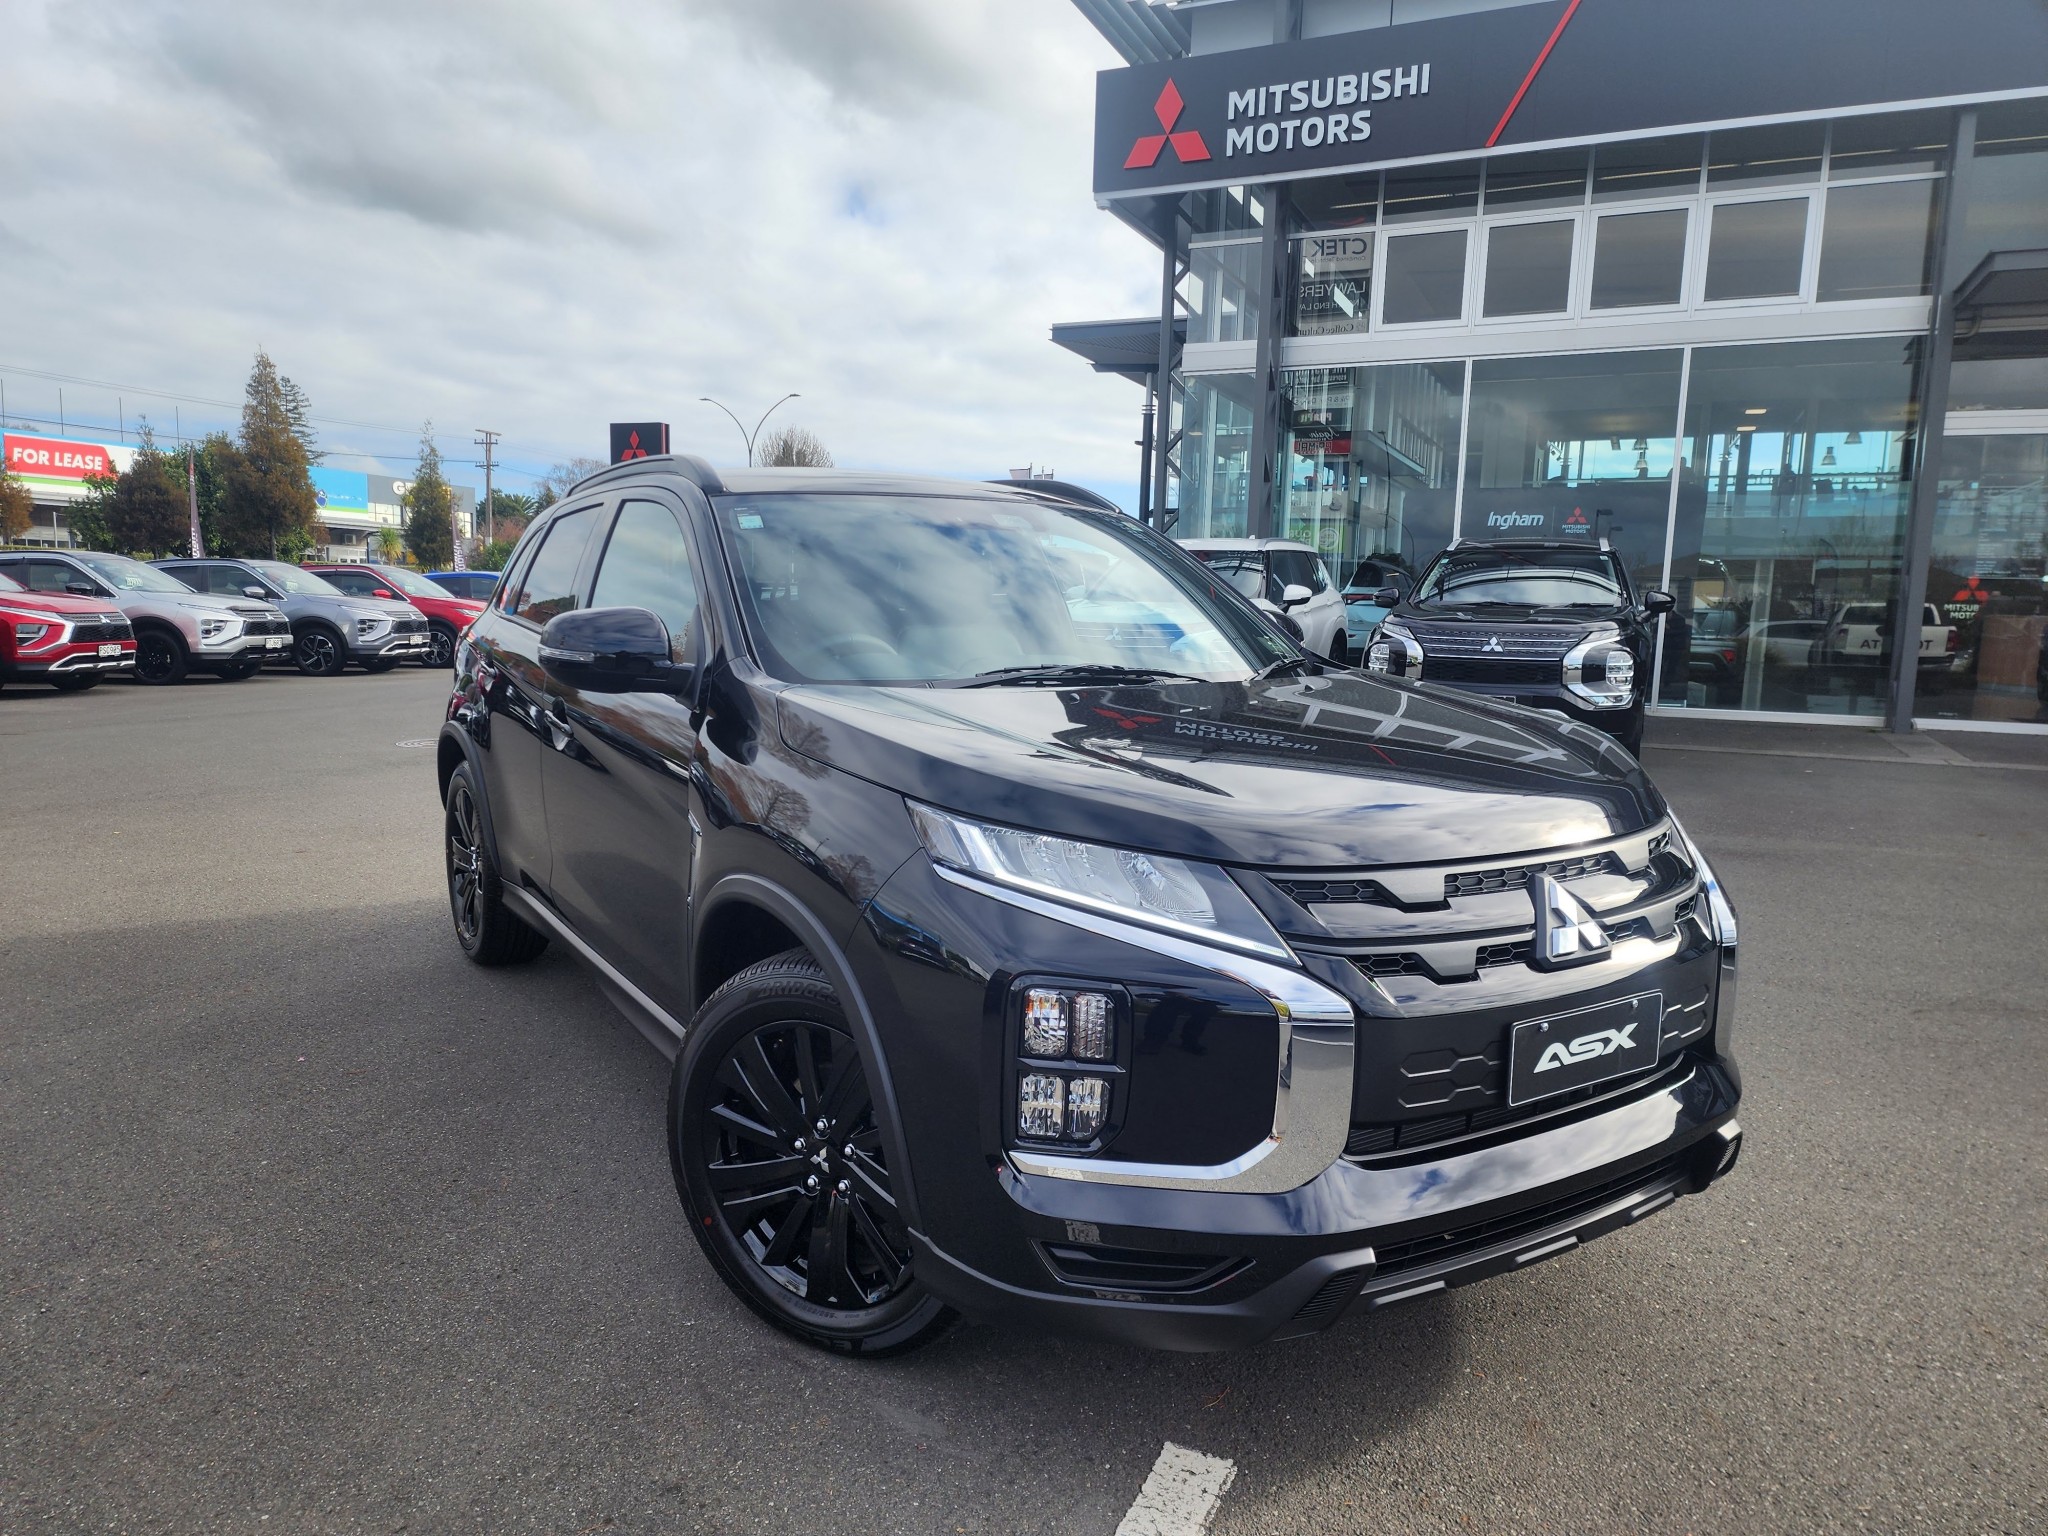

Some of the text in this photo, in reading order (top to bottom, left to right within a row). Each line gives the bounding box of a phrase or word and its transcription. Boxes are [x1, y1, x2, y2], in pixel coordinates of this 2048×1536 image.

[1227, 63, 1431, 121] MITSUBISHI
[1225, 110, 1372, 157] MOTORS
[13, 447, 103, 471] FOR LEASE
[1487, 511, 1544, 530] Ingham
[1943, 604, 1980, 612] MITSUB
[757, 981, 841, 1006] BRIDGES
[1533, 1022, 1639, 1074] ASX
